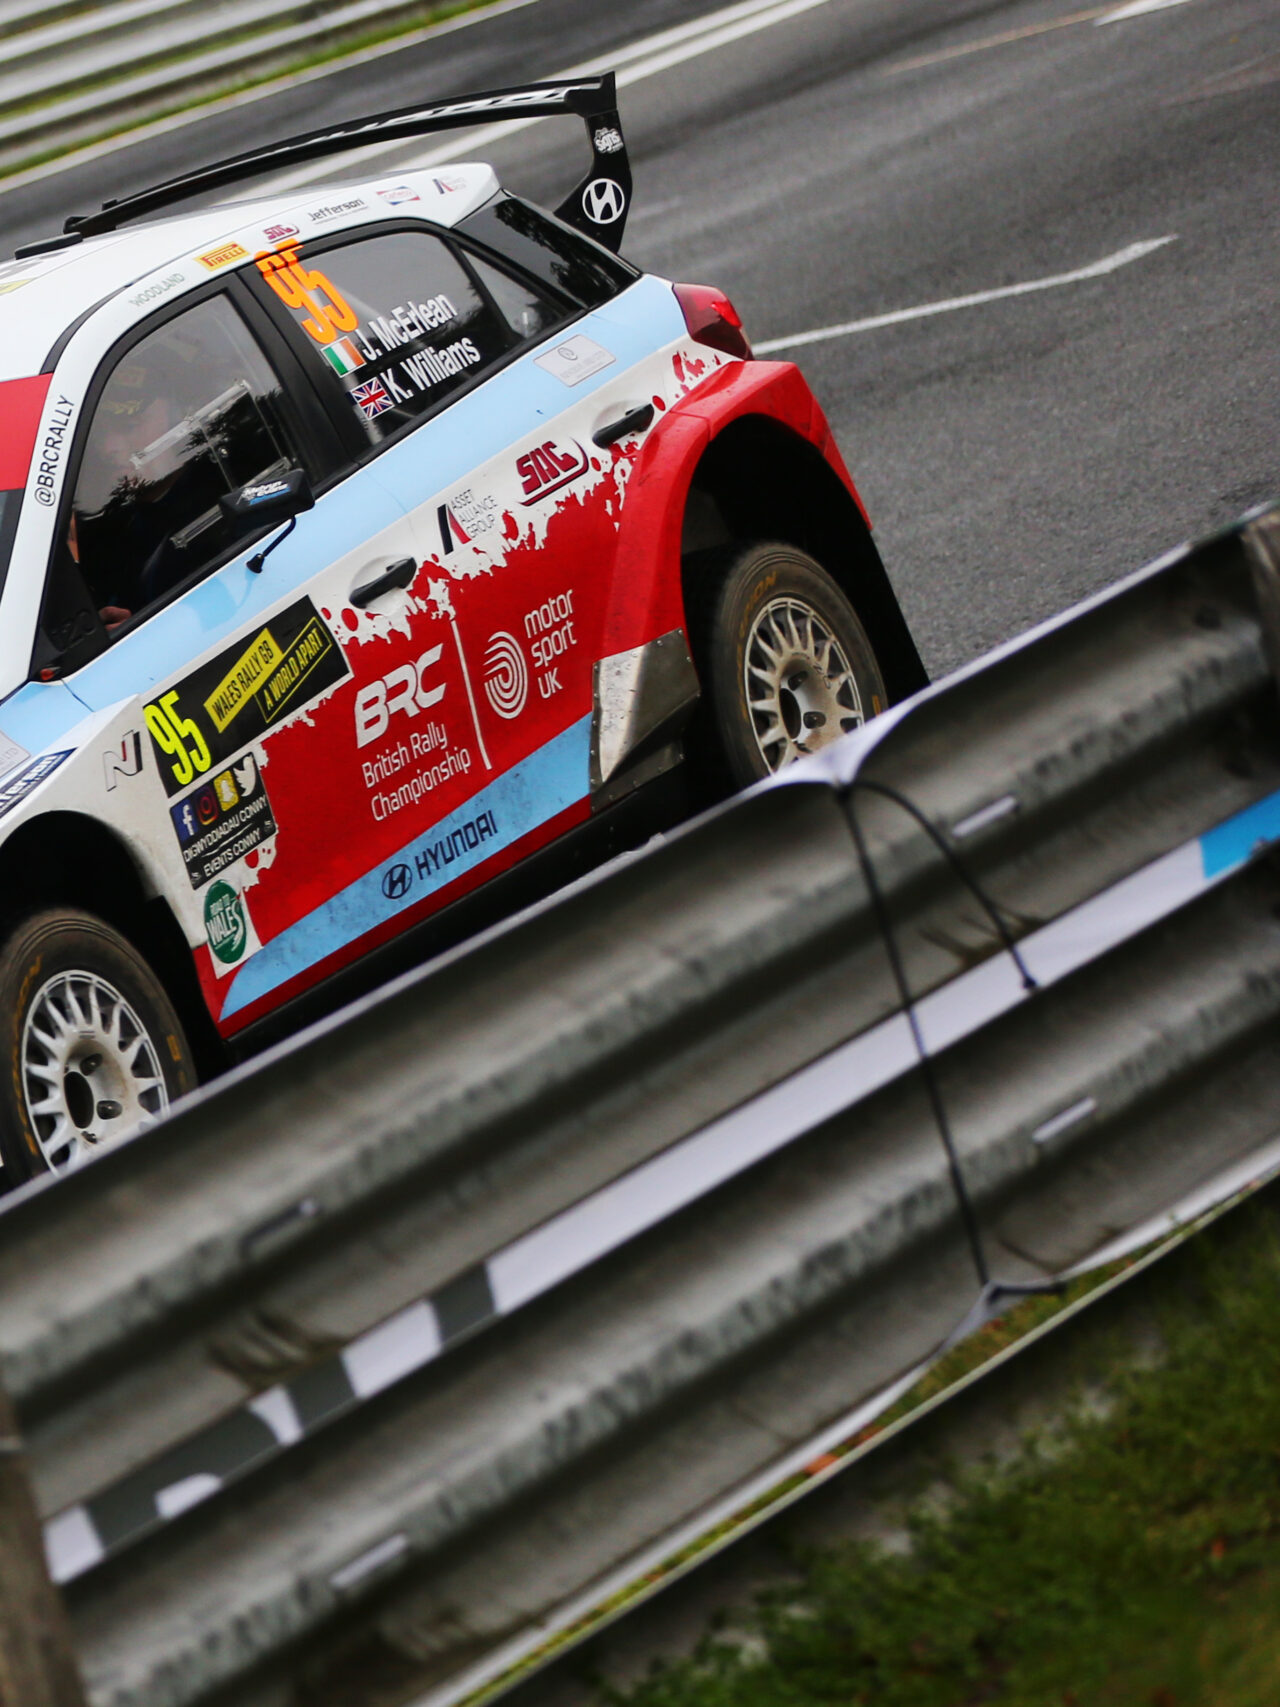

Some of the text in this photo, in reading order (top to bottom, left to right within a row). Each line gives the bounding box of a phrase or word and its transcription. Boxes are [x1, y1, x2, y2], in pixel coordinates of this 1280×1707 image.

[308, 198, 365, 221] Jefferson
[202, 243, 246, 267] PIRELLI
[128, 272, 185, 307] WOODLAND
[254, 238, 359, 344] 95
[355, 294, 458, 361] J. McErlean
[380, 337, 481, 403] K. Williams
[34, 394, 75, 507] @BRCRALLY
[451, 489, 475, 511] ASSET
[458, 495, 498, 524] ALLIANCE
[466, 514, 496, 539] GROUP
[524, 589, 574, 638] motor
[531, 621, 578, 668] sport
[212, 640, 274, 721] WALES RALLY GB
[263, 628, 323, 711] A WORLD APART
[354, 643, 446, 749] BRC
[538, 667, 563, 699] UK
[143, 690, 212, 785] 95
[361, 721, 448, 789] British Rally
[371, 747, 472, 822] Championship
[203, 848, 233, 877] EVENTS
[414, 810, 498, 880] HYUNDAI
